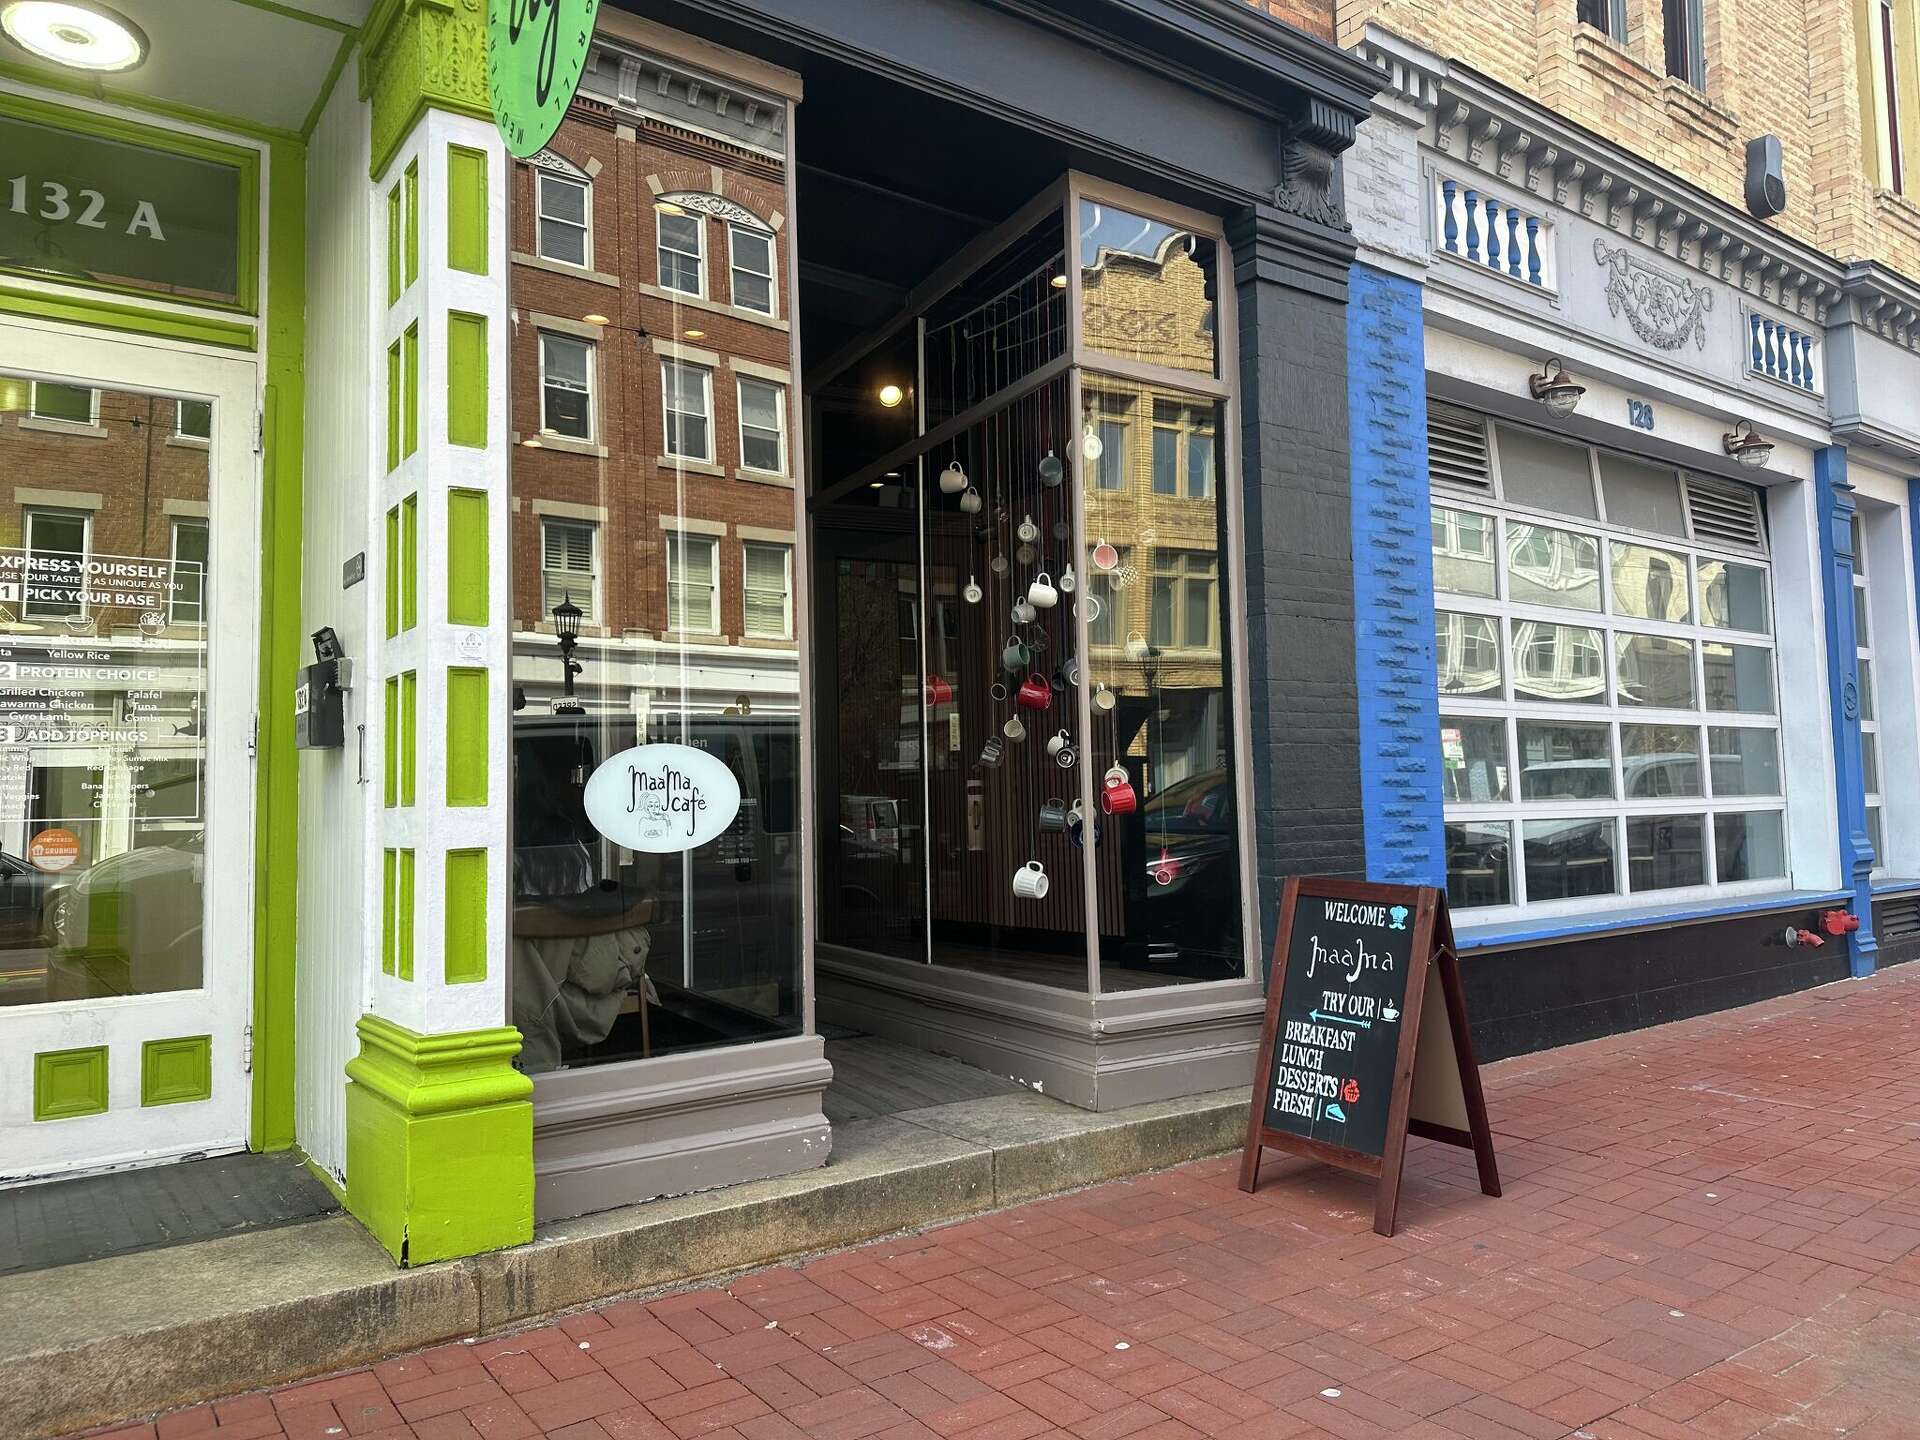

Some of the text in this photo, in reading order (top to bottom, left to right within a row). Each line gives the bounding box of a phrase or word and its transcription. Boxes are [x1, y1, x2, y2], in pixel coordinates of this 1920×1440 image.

[8, 176, 166, 241] 132 A
[1627, 398, 1655, 430] 128
[75, 561, 167, 578] YOURSELF
[20, 573, 49, 582] YOUR
[50, 575, 81, 584] TASTE
[109, 579, 147, 589] UNIQUE
[149, 581, 161, 589] AS
[163, 582, 183, 591] YOU
[25, 588, 63, 602] PICK
[65, 590, 111, 605] YOUR
[115, 593, 155, 606] BASE
[47, 650, 85, 660] Yellow
[87, 651, 111, 661] Rice
[20, 666, 91, 680] PROTEIN
[96, 669, 158, 681] CHOICE
[39, 688, 84, 698] Chicken
[127, 690, 162, 700] Falafel
[49, 700, 95, 710] Chicken
[132, 702, 158, 711] Tuna
[9, 711, 37, 722] Gyro
[40, 712, 71, 722] Lamb
[26, 729, 64, 742] ADD
[66, 731, 148, 743] TOPPINGS
[1324, 901, 1387, 927] WELCOME
[1322, 990, 1375, 1018] TRY OUR
[1285, 1020, 1356, 1052] BREAKFAST
[1281, 1043, 1324, 1071] LUNCH
[1277, 1065, 1339, 1098] DESSERTS
[1273, 1089, 1314, 1119] FRESH
